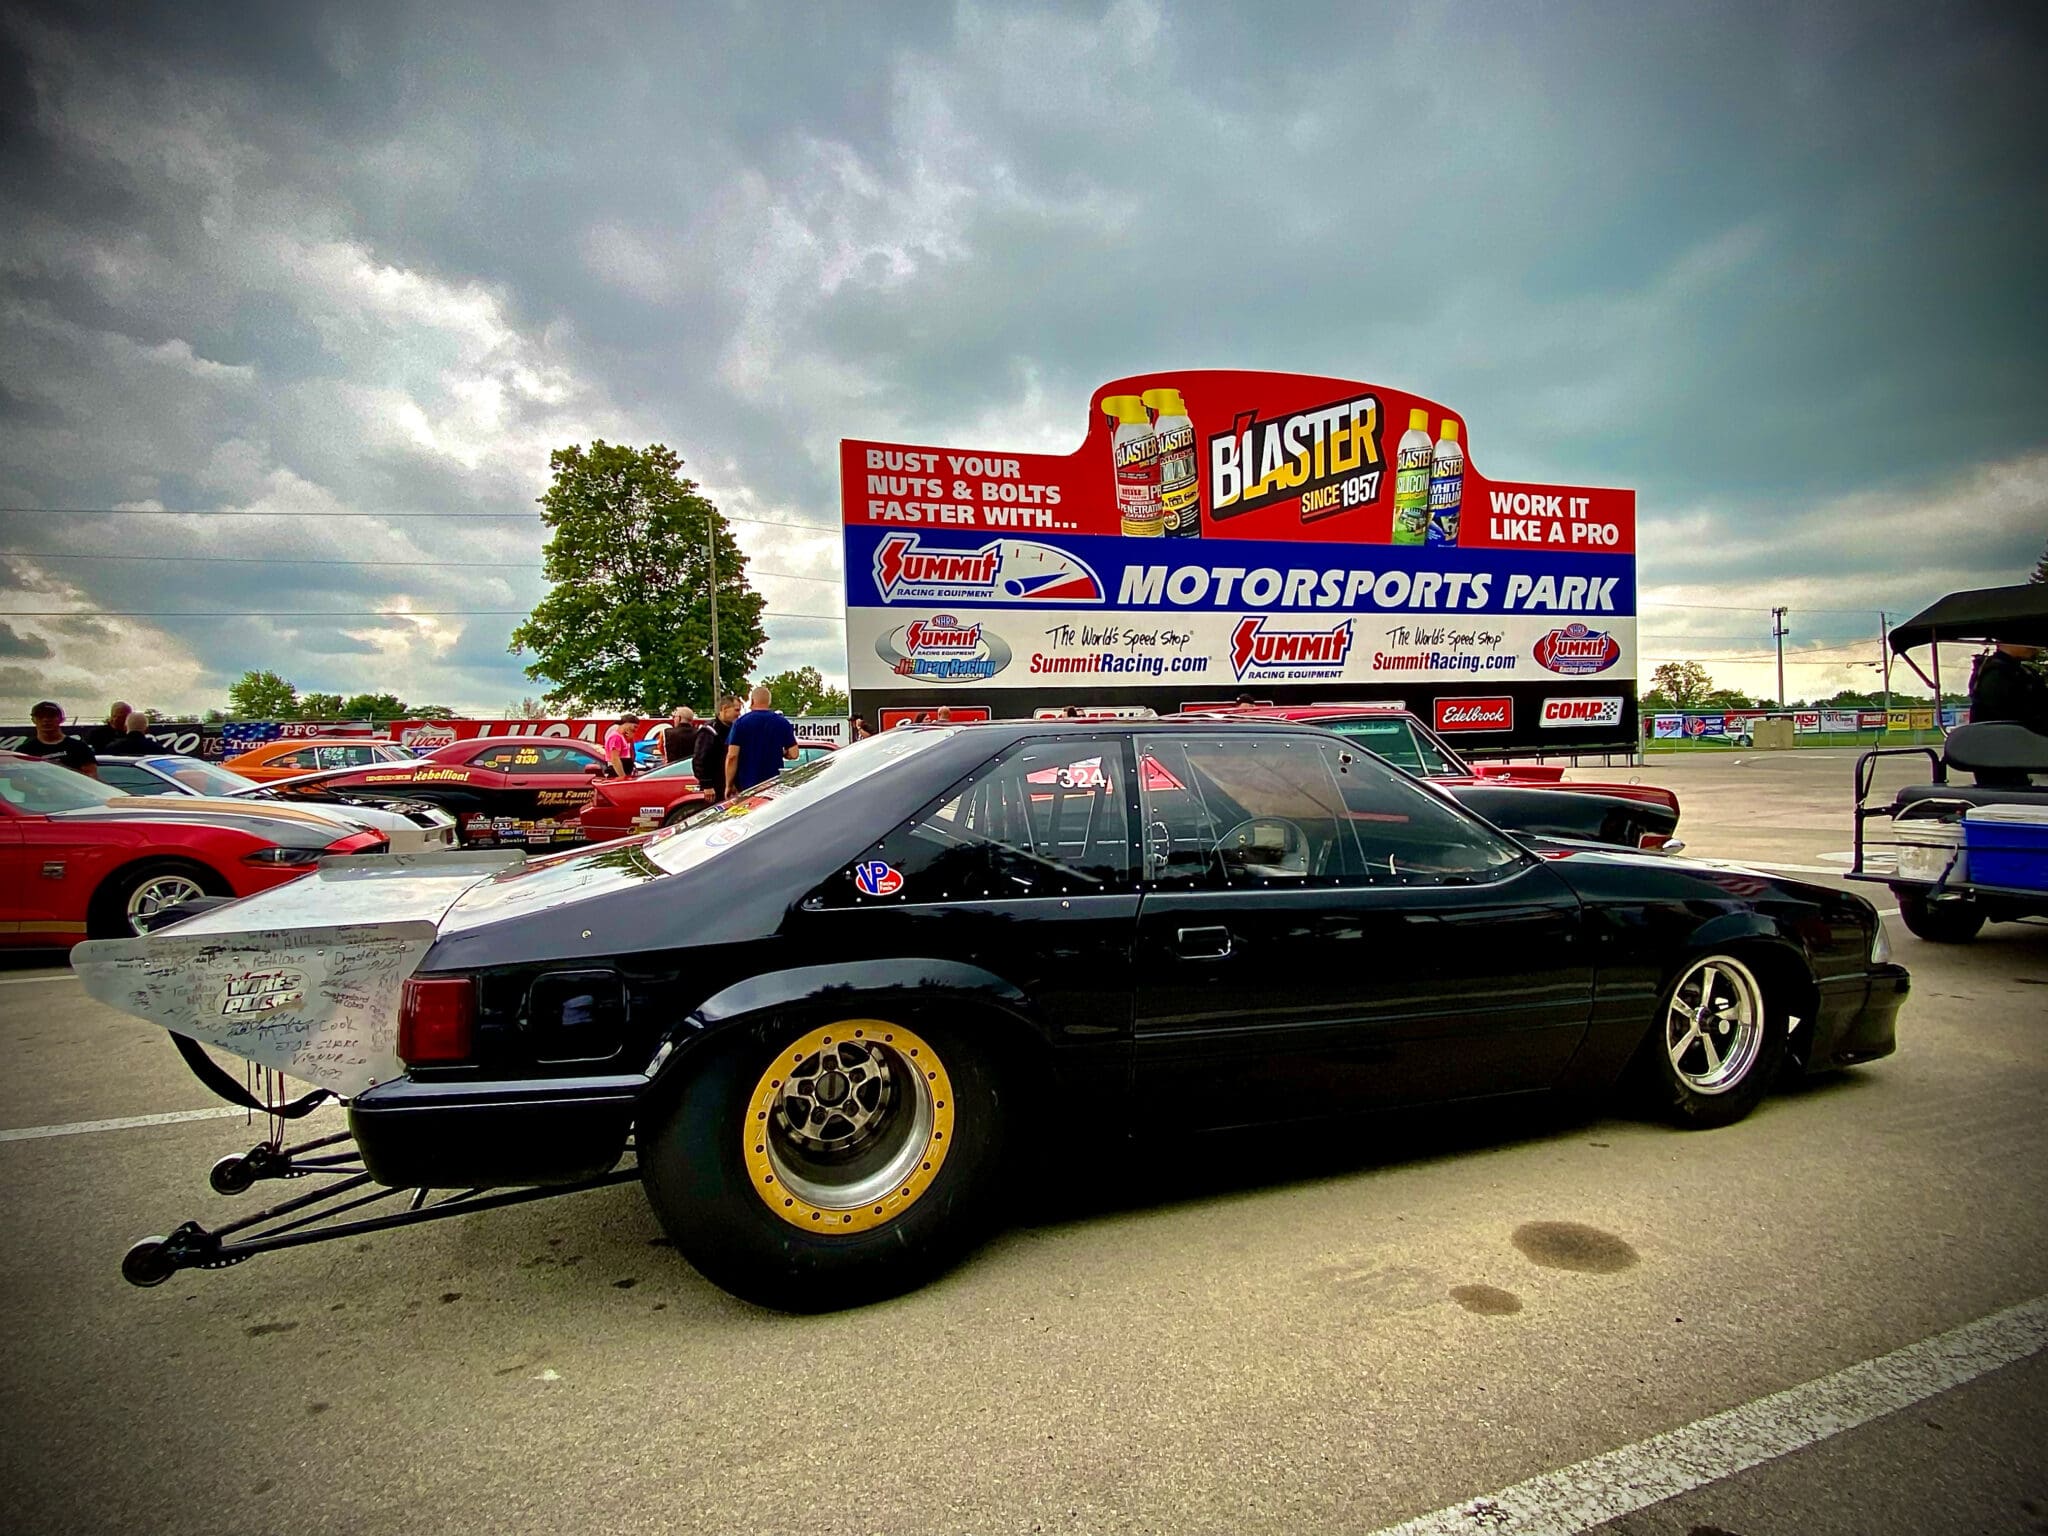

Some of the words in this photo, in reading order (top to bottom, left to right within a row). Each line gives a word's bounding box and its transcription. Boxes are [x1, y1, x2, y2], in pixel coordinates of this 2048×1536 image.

[866, 449, 939, 473] BUST
[947, 456, 1021, 479] YOUR
[867, 475, 943, 498] NUTS
[952, 481, 974, 500] &
[982, 482, 1062, 504] BOLTS
[1302, 484, 1340, 513] SINCE
[1340, 471, 1379, 507] 1957
[1397, 473, 1430, 493] SILICON
[868, 500, 975, 524] FASTER
[983, 506, 1078, 529] WITH...
[1120, 504, 1163, 514] PENETRATI
[1489, 491, 1564, 518] WORK
[1570, 497, 1590, 519] IT
[1490, 518, 1542, 542] LIKE
[1548, 522, 1566, 543] A
[1572, 523, 1619, 545] PRO
[897, 588, 935, 597] RACING
[937, 589, 994, 598] EQUIPMENT
[1118, 565, 1493, 609] MOTORSPORTS
[1504, 574, 1620, 611] PARK
[935, 617, 955, 626] NHRA
[1045, 624, 1075, 649] The
[1081, 625, 1119, 646] World's
[1122, 629, 1157, 653] Speed
[1160, 629, 1190, 652] Shop
[1385, 626, 1410, 649] The
[1414, 626, 1445, 646] World's
[1447, 630, 1476, 652] Speed
[1478, 631, 1501, 651] Shop
[914, 659, 948, 678] Drag
[949, 659, 996, 677] Racing
[1030, 653, 1208, 676] SummitRacing.com
[1372, 652, 1516, 673] SummitRacing.com
[1248, 671, 1285, 679] RACING
[1287, 670, 1343, 679] EQUIPMENT
[1442, 705, 1505, 724] Edelbrock
[1545, 702, 1603, 720] COMP
[1584, 714, 1613, 722] CAMS
[791, 723, 840, 736] Harland
[231, 740, 266, 750] Tran
[409, 736, 453, 747] LUCAS
[413, 769, 470, 783] Rebellion!
[1058, 768, 1106, 788] 324
[565, 790, 594, 798] Fami
[857, 862, 889, 894] VP
[228, 975, 302, 997] WIRES
